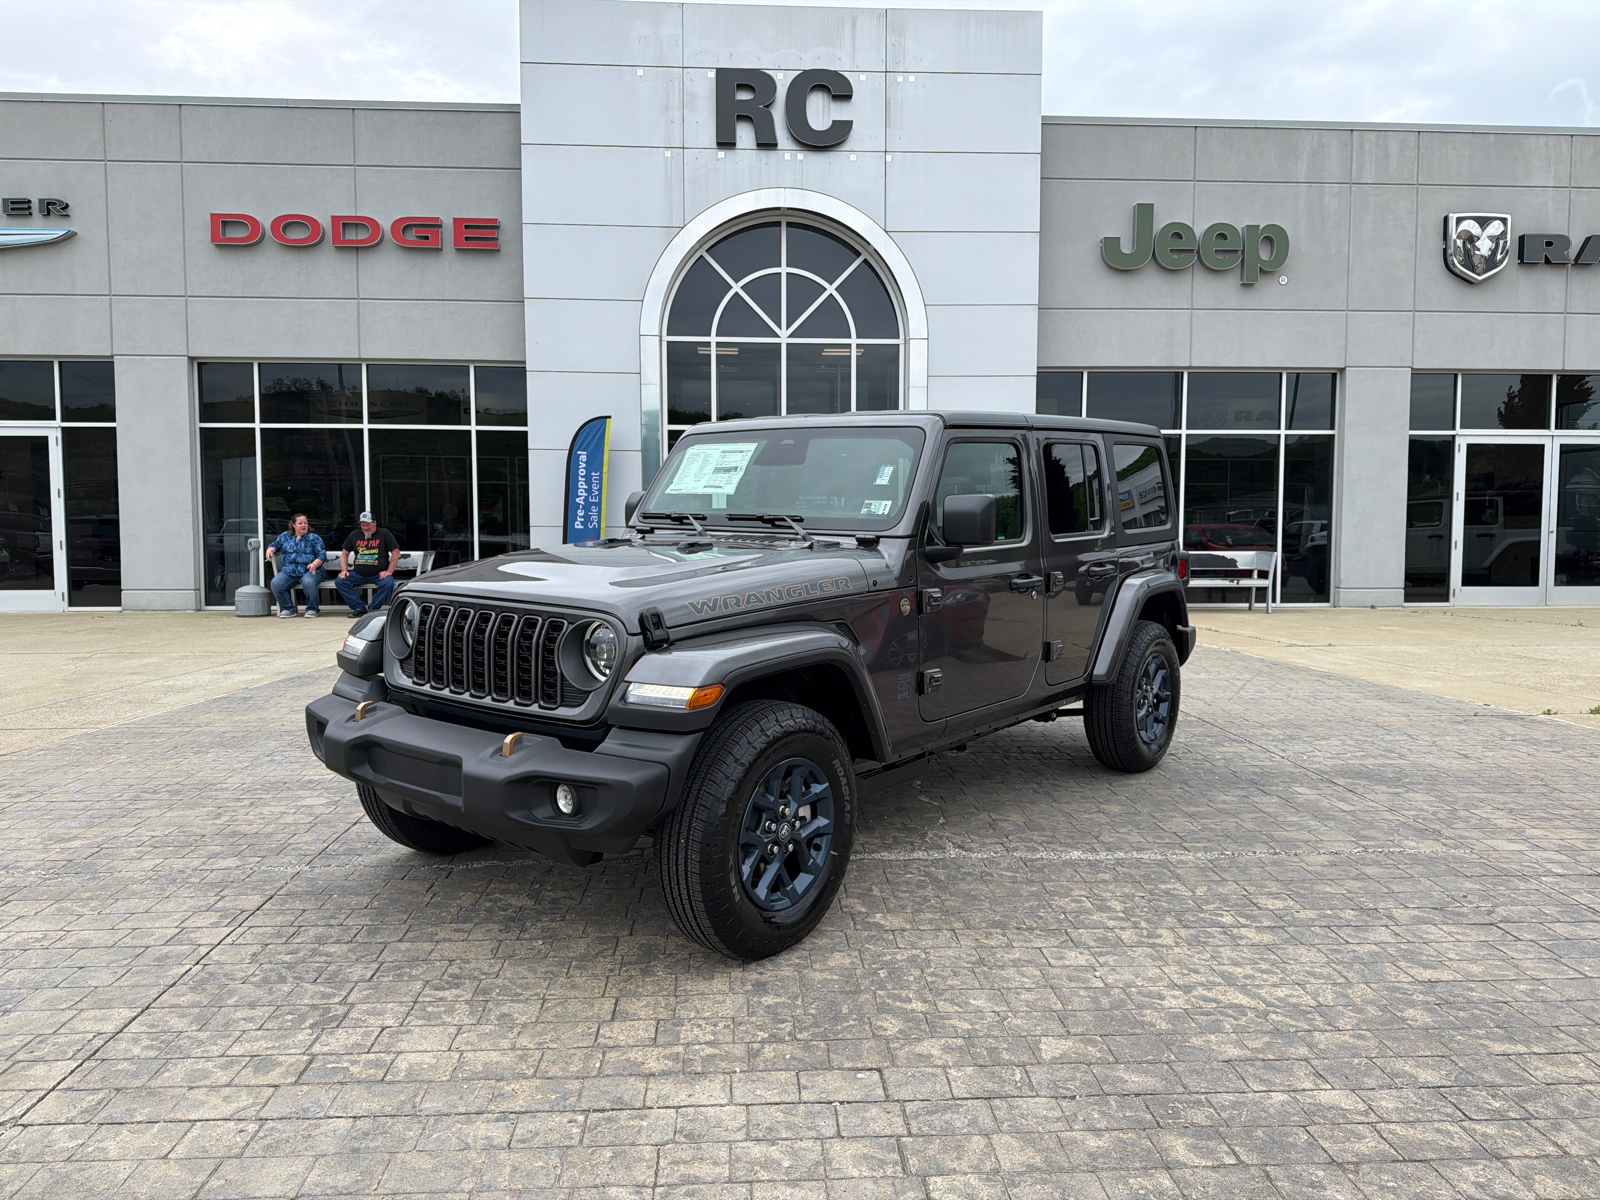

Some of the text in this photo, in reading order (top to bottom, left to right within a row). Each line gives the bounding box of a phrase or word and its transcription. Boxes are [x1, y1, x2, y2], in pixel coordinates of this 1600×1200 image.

[715, 68, 854, 149] RC
[209, 212, 501, 251] DODGE
[1100, 203, 1290, 286] Jeep
[574, 450, 588, 529] Pre-Approval
[589, 471, 600, 502] Event
[588, 503, 599, 529] Sale
[686, 576, 853, 616] WRANGLER
[832, 758, 851, 825] ROADIAN
